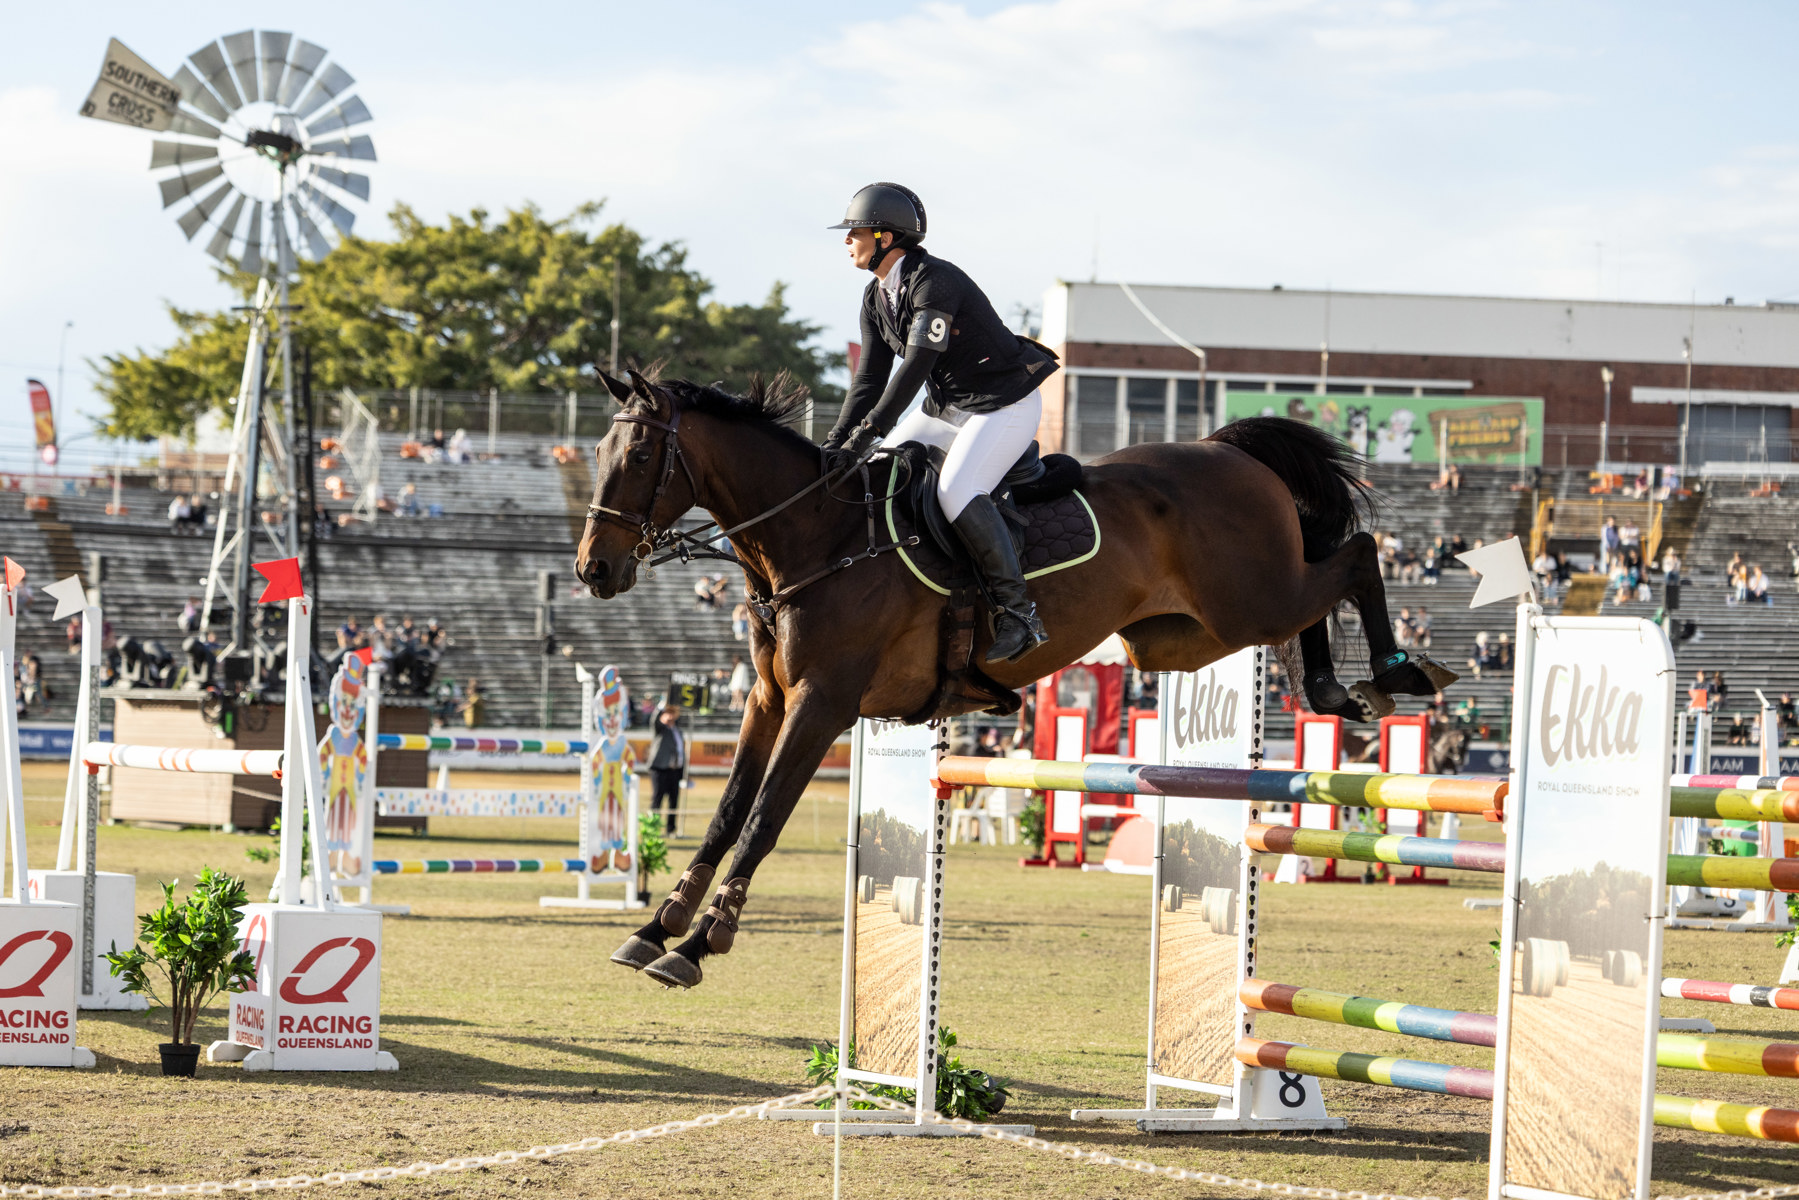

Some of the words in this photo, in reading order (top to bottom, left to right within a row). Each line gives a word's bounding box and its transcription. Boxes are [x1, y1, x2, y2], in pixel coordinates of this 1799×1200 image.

[105, 61, 180, 104] SOUTHERN
[108, 91, 156, 124] CROSS
[927, 317, 946, 343] 9
[1174, 667, 1239, 749] Ekka
[1540, 663, 1643, 767] Ekka
[911, 749, 926, 758] SHOW
[1712, 758, 1744, 772] AAM
[1780, 759, 1799, 774] AA
[1537, 781, 1560, 793] ROYAL
[1562, 783, 1614, 795] QUEENSLAND
[1616, 786, 1640, 796] SHOW
[0, 1009, 69, 1029] ACING
[236, 1003, 265, 1031] RACING
[278, 1015, 373, 1034] RACING
[0, 1032, 70, 1044] ENSLAND
[277, 1037, 373, 1049] QUEENSLAND
[1279, 1070, 1306, 1108] 8
